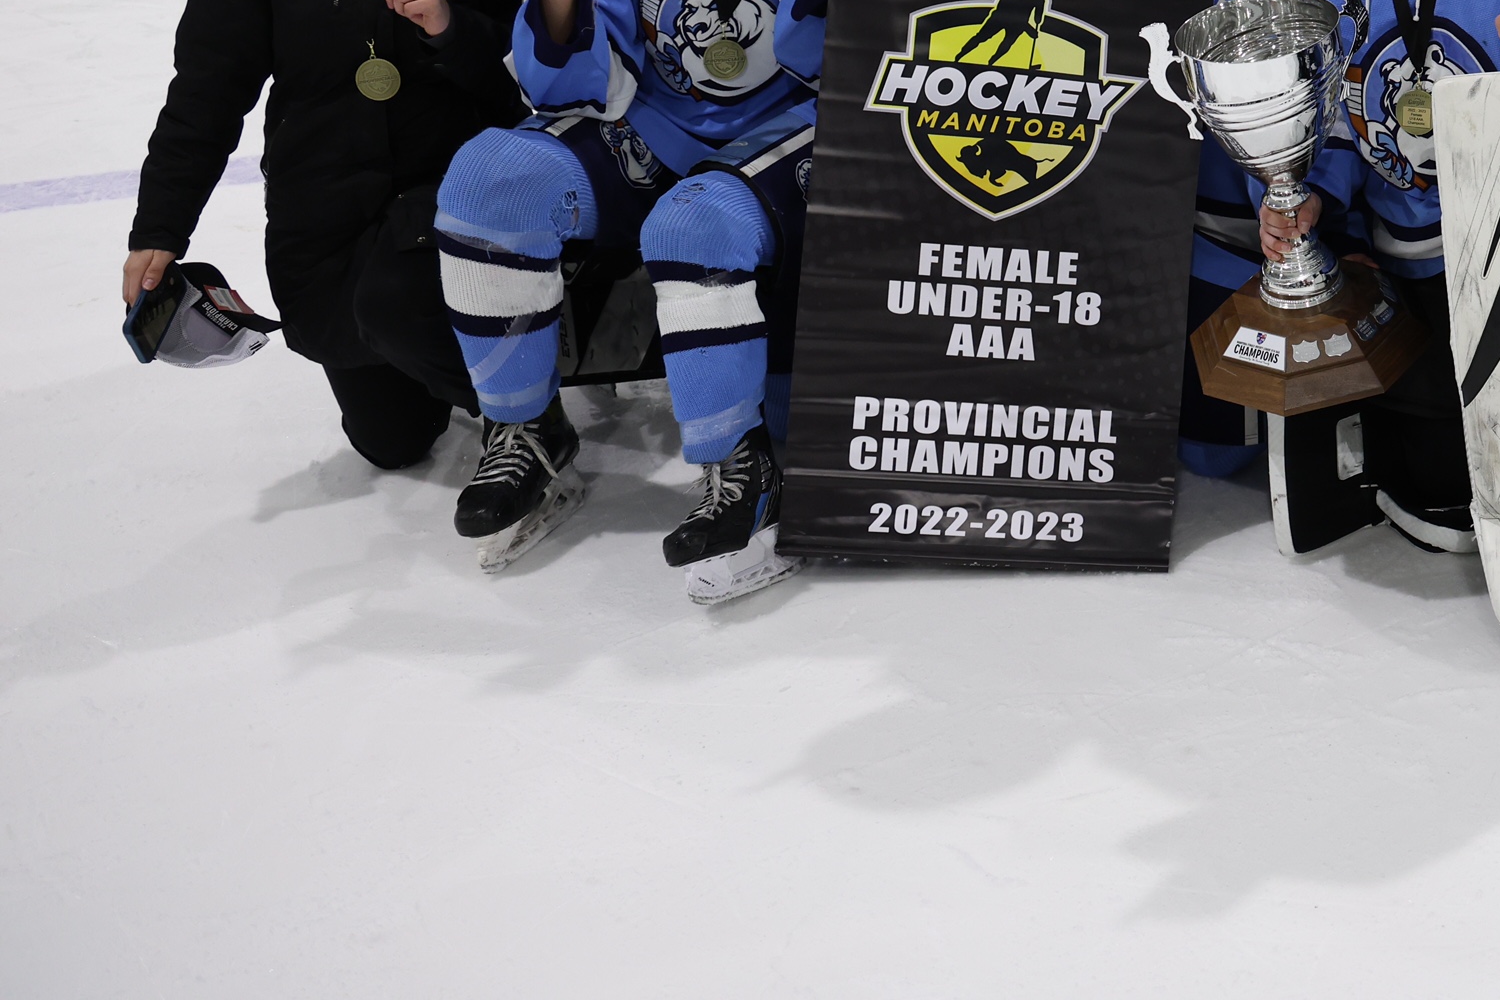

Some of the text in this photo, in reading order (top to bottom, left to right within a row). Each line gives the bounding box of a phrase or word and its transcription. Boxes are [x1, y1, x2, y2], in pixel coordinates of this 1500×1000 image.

[879, 62, 1127, 122] HOCKEY
[916, 108, 1087, 143] MANITOBA
[918, 242, 1079, 287] FEMALE
[201, 301, 239, 331] CHAMPIONS
[886, 281, 1102, 326] UNDER-18
[945, 323, 1036, 362] AAA
[1233, 343, 1280, 364] CHAMPIONS
[852, 395, 1117, 446] PROVINCIAL
[847, 435, 1115, 485] CHAMPIONS
[868, 503, 1084, 543] 2022-2023
